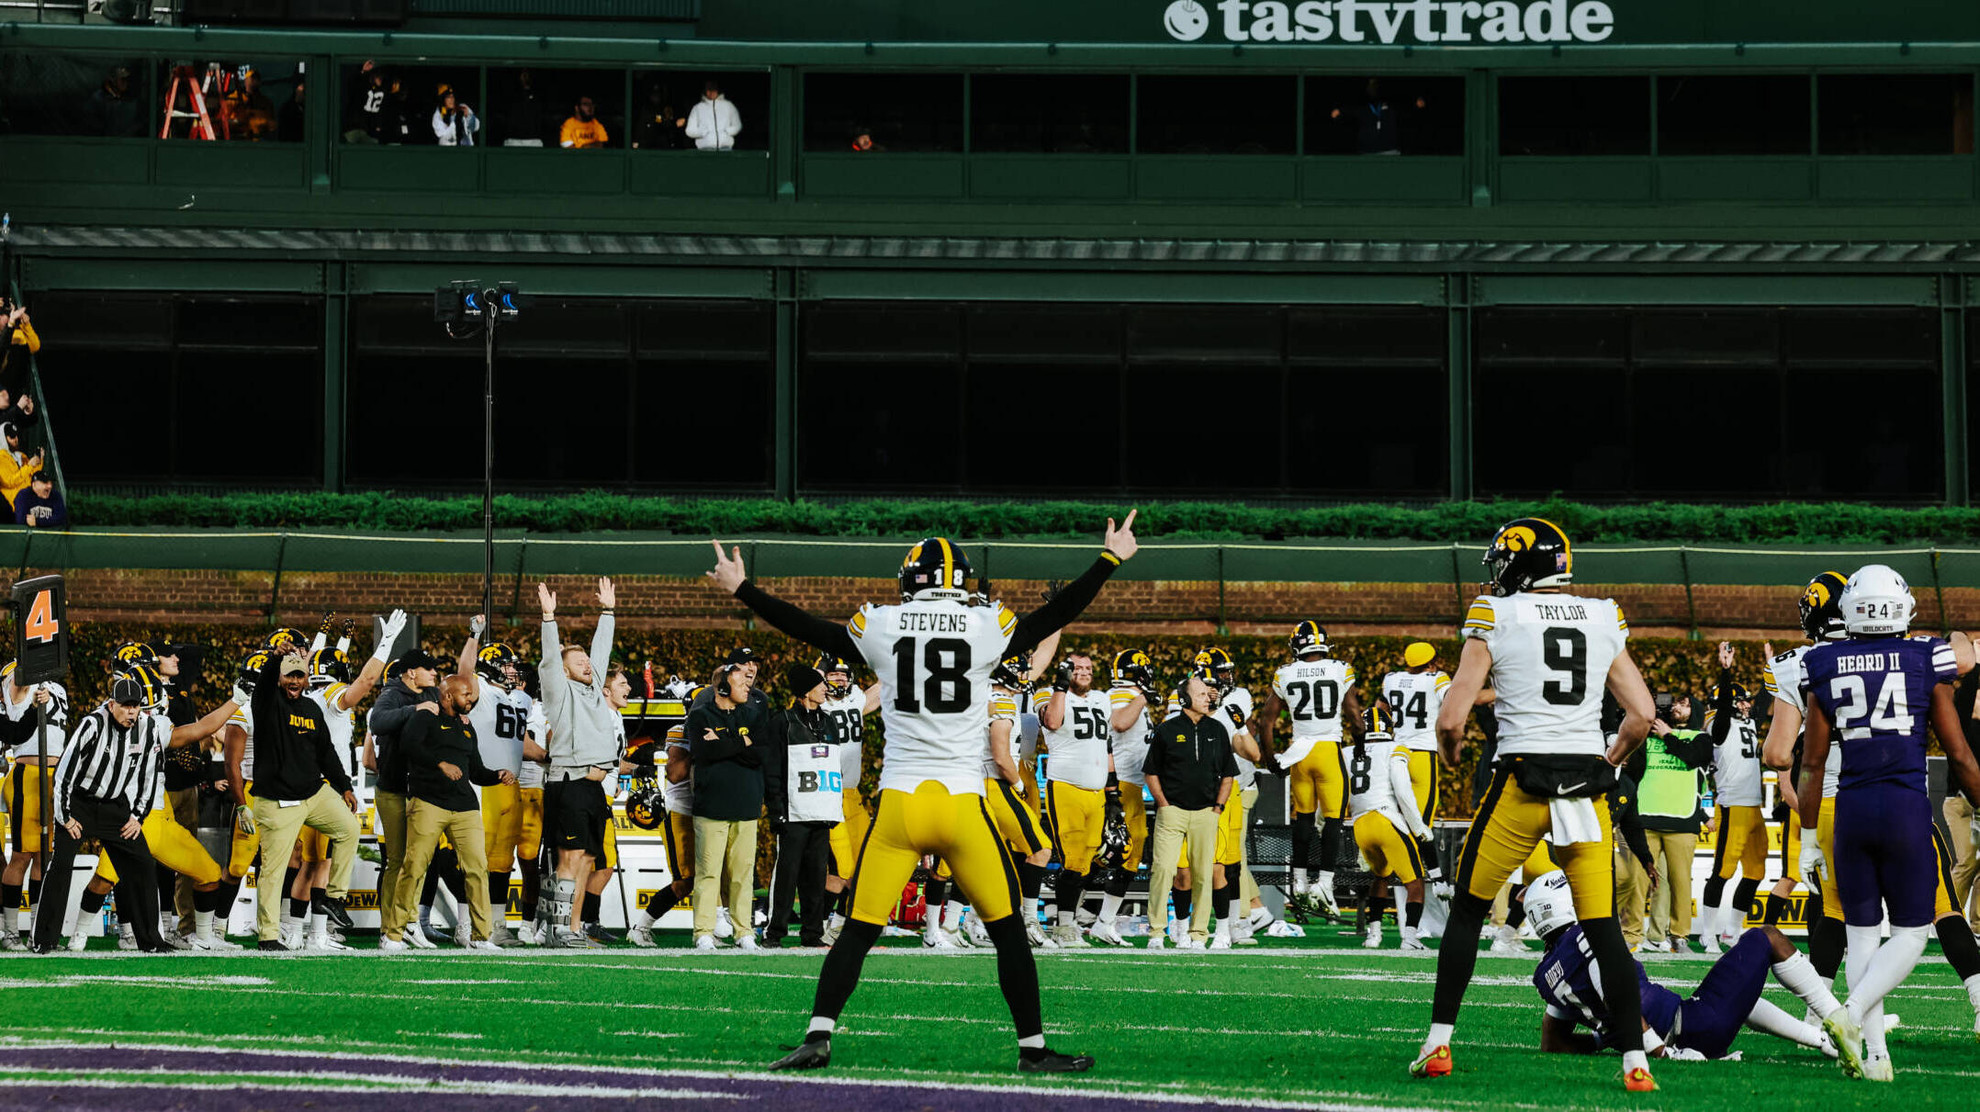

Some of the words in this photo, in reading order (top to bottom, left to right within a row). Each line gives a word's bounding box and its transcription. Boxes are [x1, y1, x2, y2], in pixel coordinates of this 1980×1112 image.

[1218, 0, 1614, 43] tastytrade
[363, 89, 385, 113] 12
[934, 569, 963, 585] 18
[25, 589, 58, 643] 4
[899, 613, 967, 632] STEVENS
[1535, 604, 1587, 620] TAYLOR
[1868, 603, 1888, 618] 24
[892, 636, 972, 714] 18
[1297, 667, 1326, 678] HILSON
[1541, 626, 1587, 705] 9
[1837, 653, 1885, 674] HEARD
[1888, 652, 1901, 671] II
[1286, 680, 1339, 721] 20
[1389, 690, 1428, 729] 84
[1830, 672, 1915, 741] 24
[830, 708, 863, 743] 88
[1072, 706, 1109, 741] 56
[1350, 755, 1372, 796] 8
[344, 893, 381, 907] DEW
